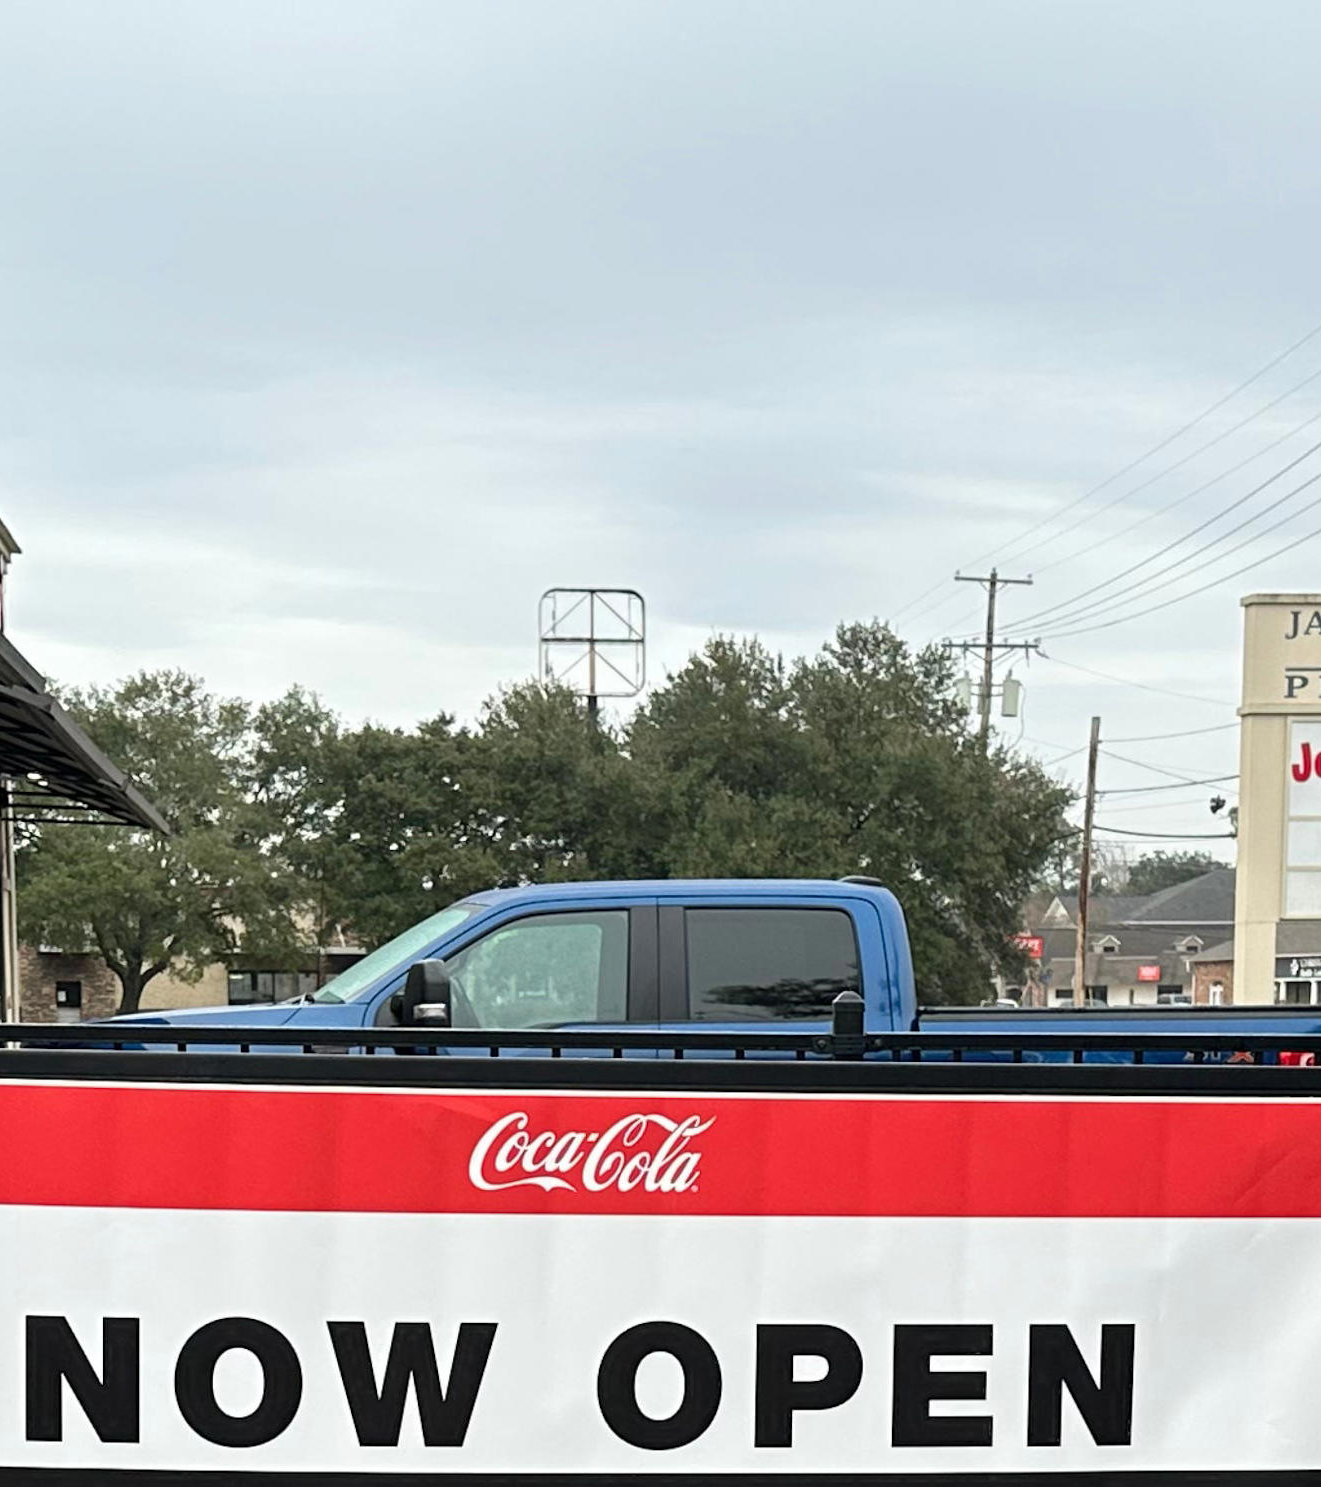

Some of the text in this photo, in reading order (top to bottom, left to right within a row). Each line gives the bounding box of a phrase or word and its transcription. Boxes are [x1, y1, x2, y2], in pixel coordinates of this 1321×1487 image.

[469, 1112, 716, 1192] Coca-Cola
[26, 1315, 1135, 1450] NOW OPEN
